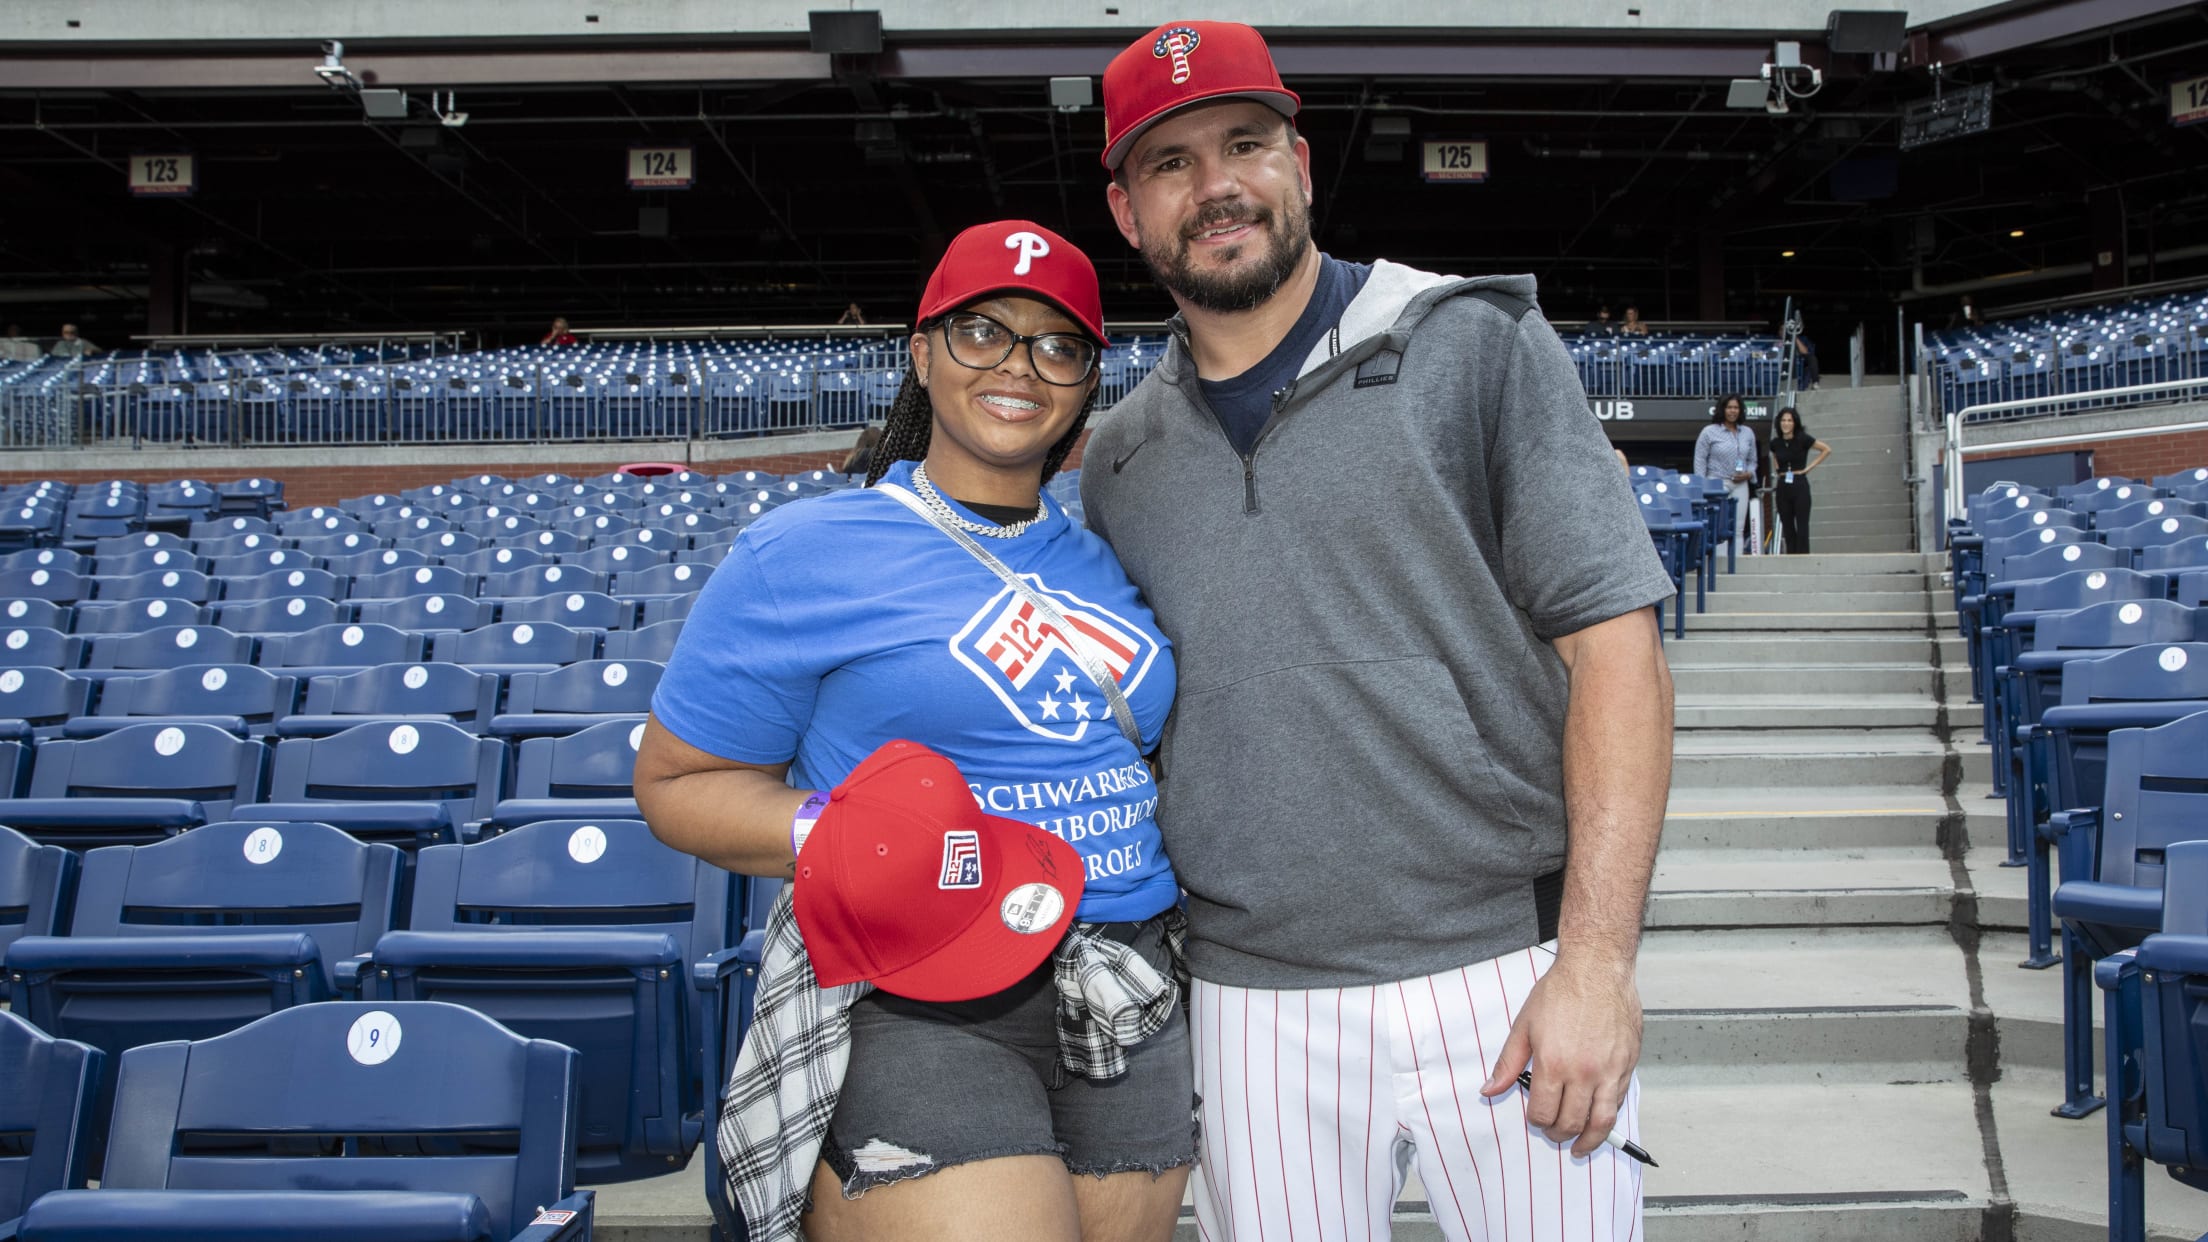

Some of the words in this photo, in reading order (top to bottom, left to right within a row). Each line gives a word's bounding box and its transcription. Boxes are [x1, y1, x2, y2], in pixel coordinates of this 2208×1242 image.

[1152, 27, 1201, 85] P
[643, 152, 677, 176] 124
[1438, 145, 1472, 169] 125
[144, 159, 178, 183] 123
[1004, 231, 1050, 276] P
[1357, 375, 1394, 385] PHILLIES
[1595, 401, 1634, 420] UB
[1000, 618, 1044, 664] 12
[401, 734, 407, 745] 8
[1030, 796, 1158, 842] HBORHOO
[259, 839, 267, 852] 8
[370, 1028, 380, 1048] 9
